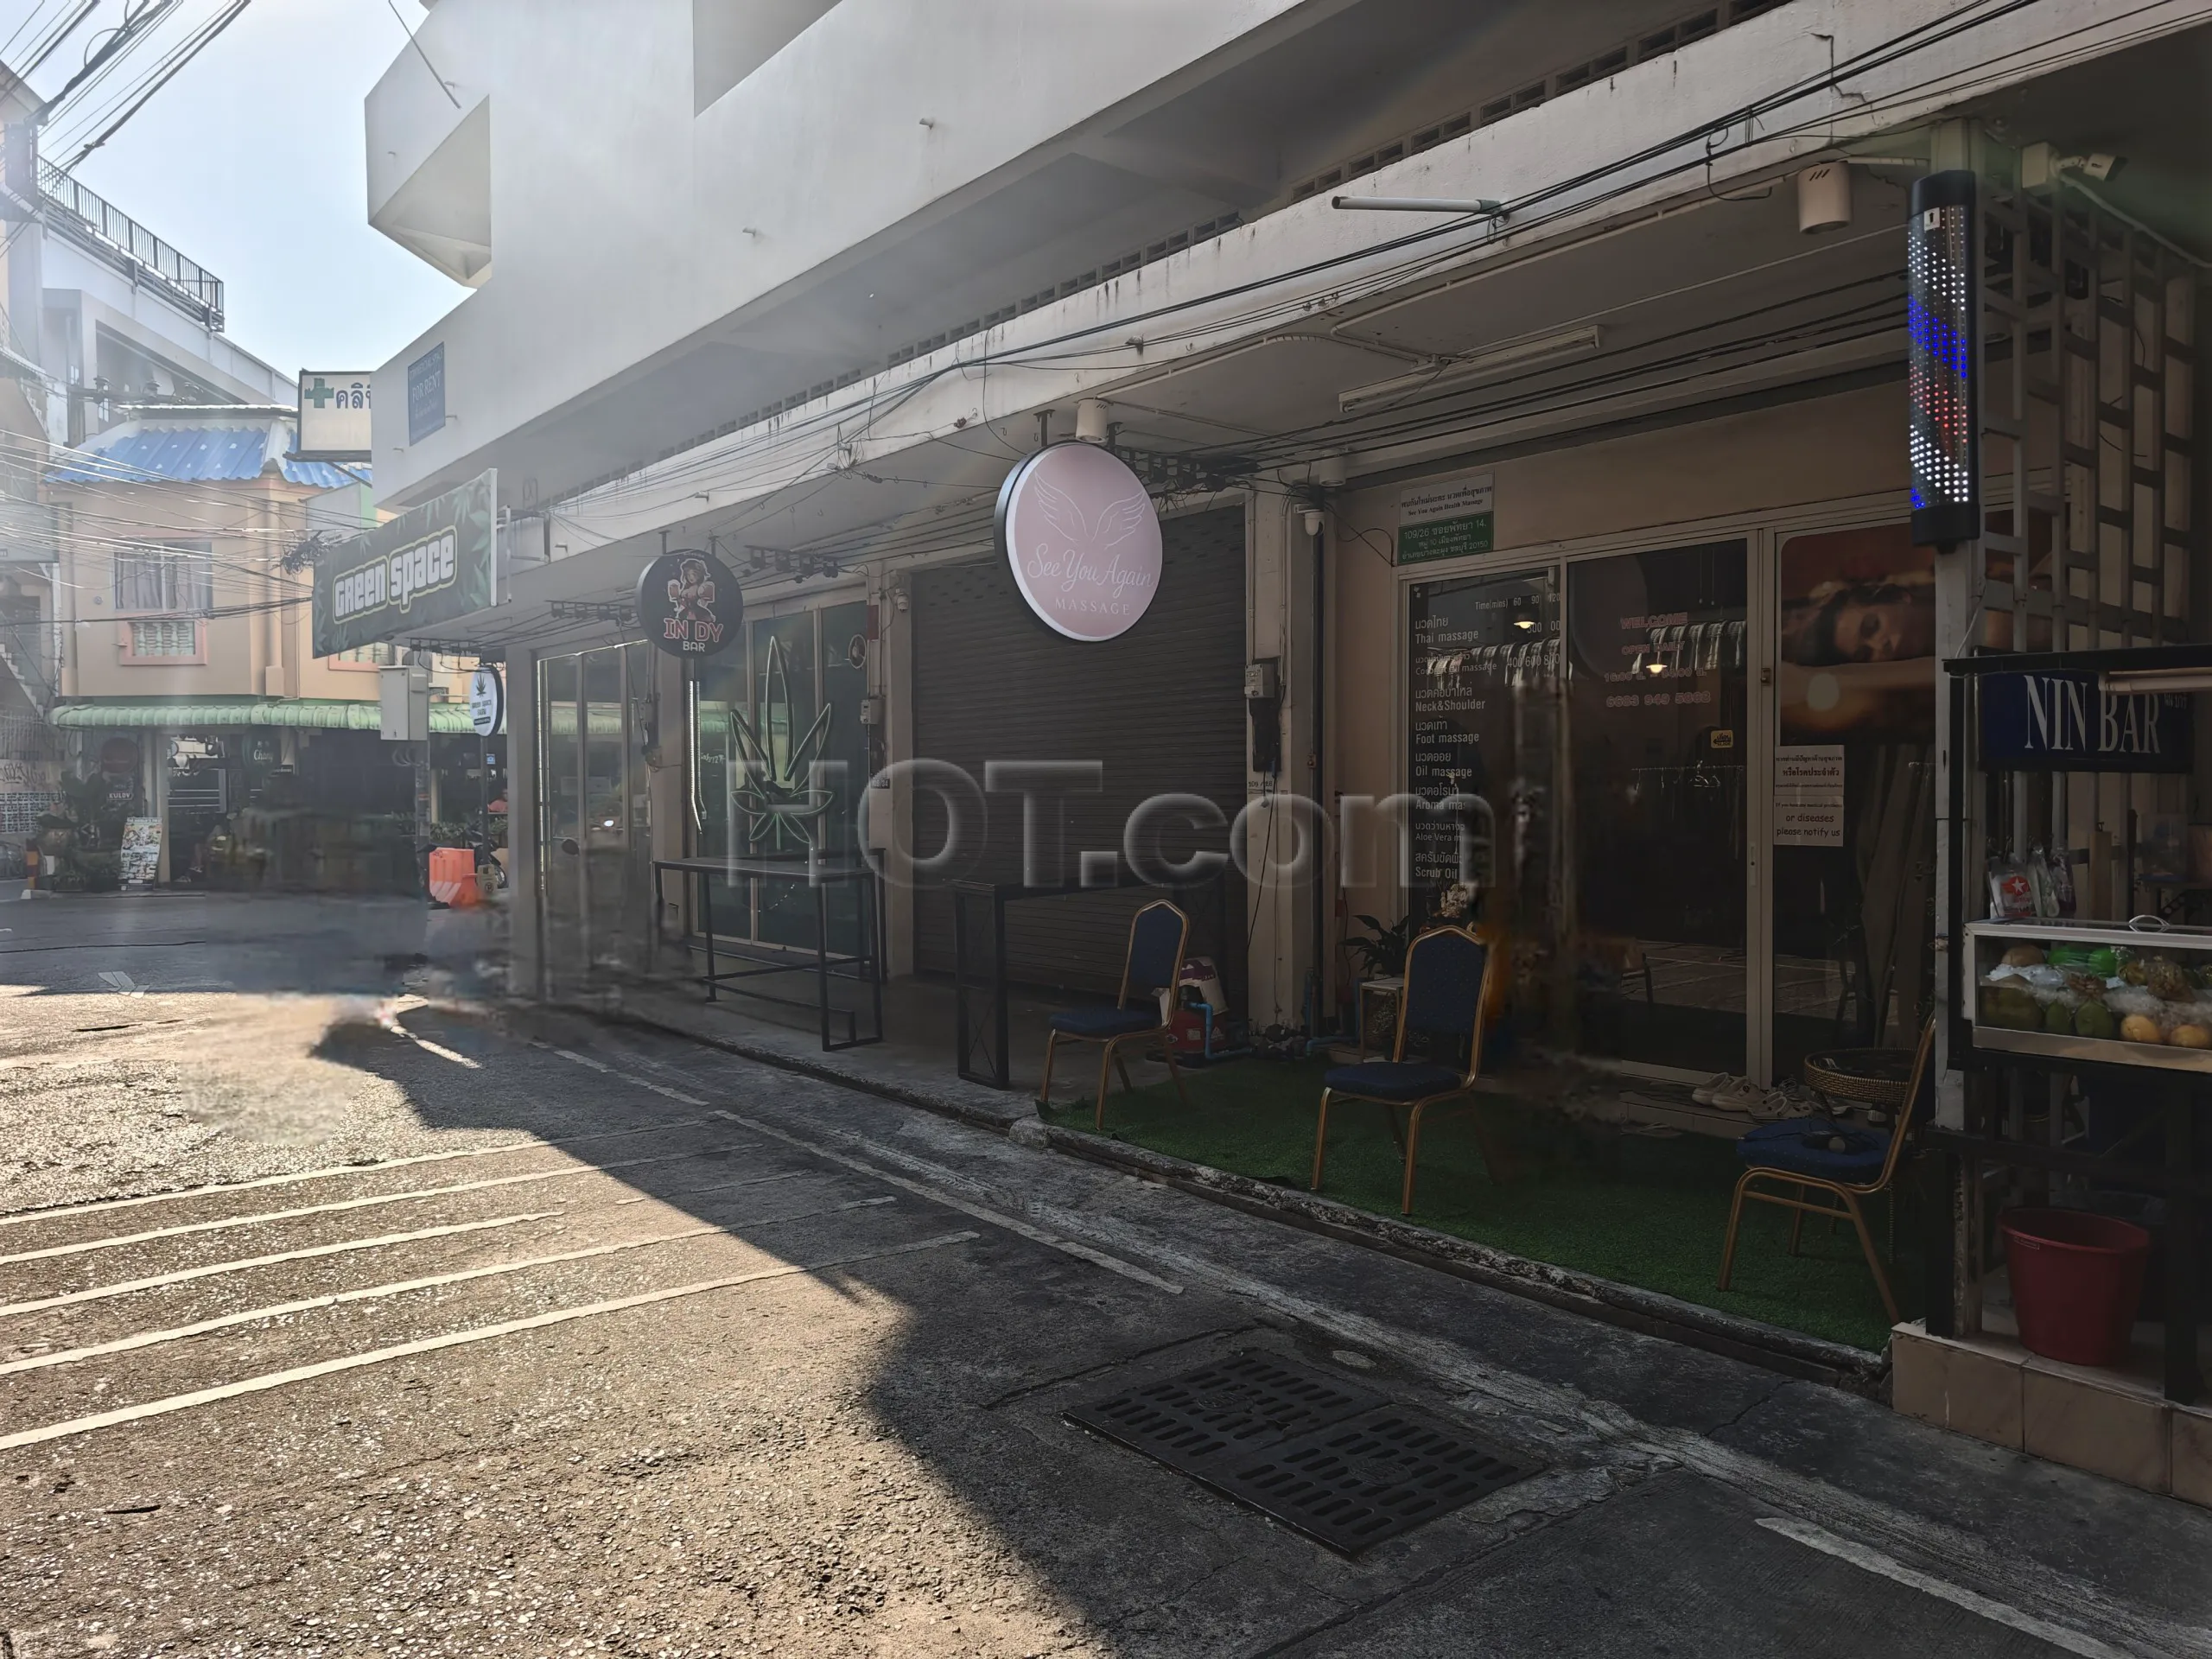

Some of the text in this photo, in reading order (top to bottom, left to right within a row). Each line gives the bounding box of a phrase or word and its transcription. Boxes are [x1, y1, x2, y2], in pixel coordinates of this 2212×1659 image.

[412, 371, 442, 404] FOR RENT
[1462, 499, 1484, 507] Massage
[1404, 528, 1429, 539] 109/26
[1469, 540, 1488, 550] 20150
[1027, 543, 1155, 599] See You Again
[1055, 598, 1130, 615] MASSAGE
[1513, 597, 1522, 607] 60
[1531, 594, 1540, 605] 90
[1415, 615, 1449, 629] นวดไทย
[1619, 612, 1688, 630] WELCOME
[664, 618, 724, 643] IN DY
[1415, 632, 1434, 644] Thai
[1438, 630, 1478, 642] massage
[683, 641, 706, 652] BAR
[1621, 640, 1686, 656] OPEN DAILY
[1462, 663, 1497, 673] massage
[1507, 657, 1522, 668] 400
[1525, 656, 1542, 667] 600
[1415, 699, 1485, 712] Neck&Shoulder
[2024, 675, 2161, 754] NIN BAR
[1415, 715, 1447, 731] นวดเท้า
[1415, 733, 1479, 744] Foot massage
[1415, 753, 1452, 761] นวดออย
[1415, 765, 1472, 779] Oil massage
[1415, 798, 1444, 810] Aroma
[1797, 813, 1834, 822] diseases
[1415, 832, 1433, 841] Aloe
[1434, 832, 1452, 842] Vera
[1777, 827, 1802, 837] please
[1803, 828, 1828, 838] notify
[1415, 866, 1458, 880] Scrub Oil
